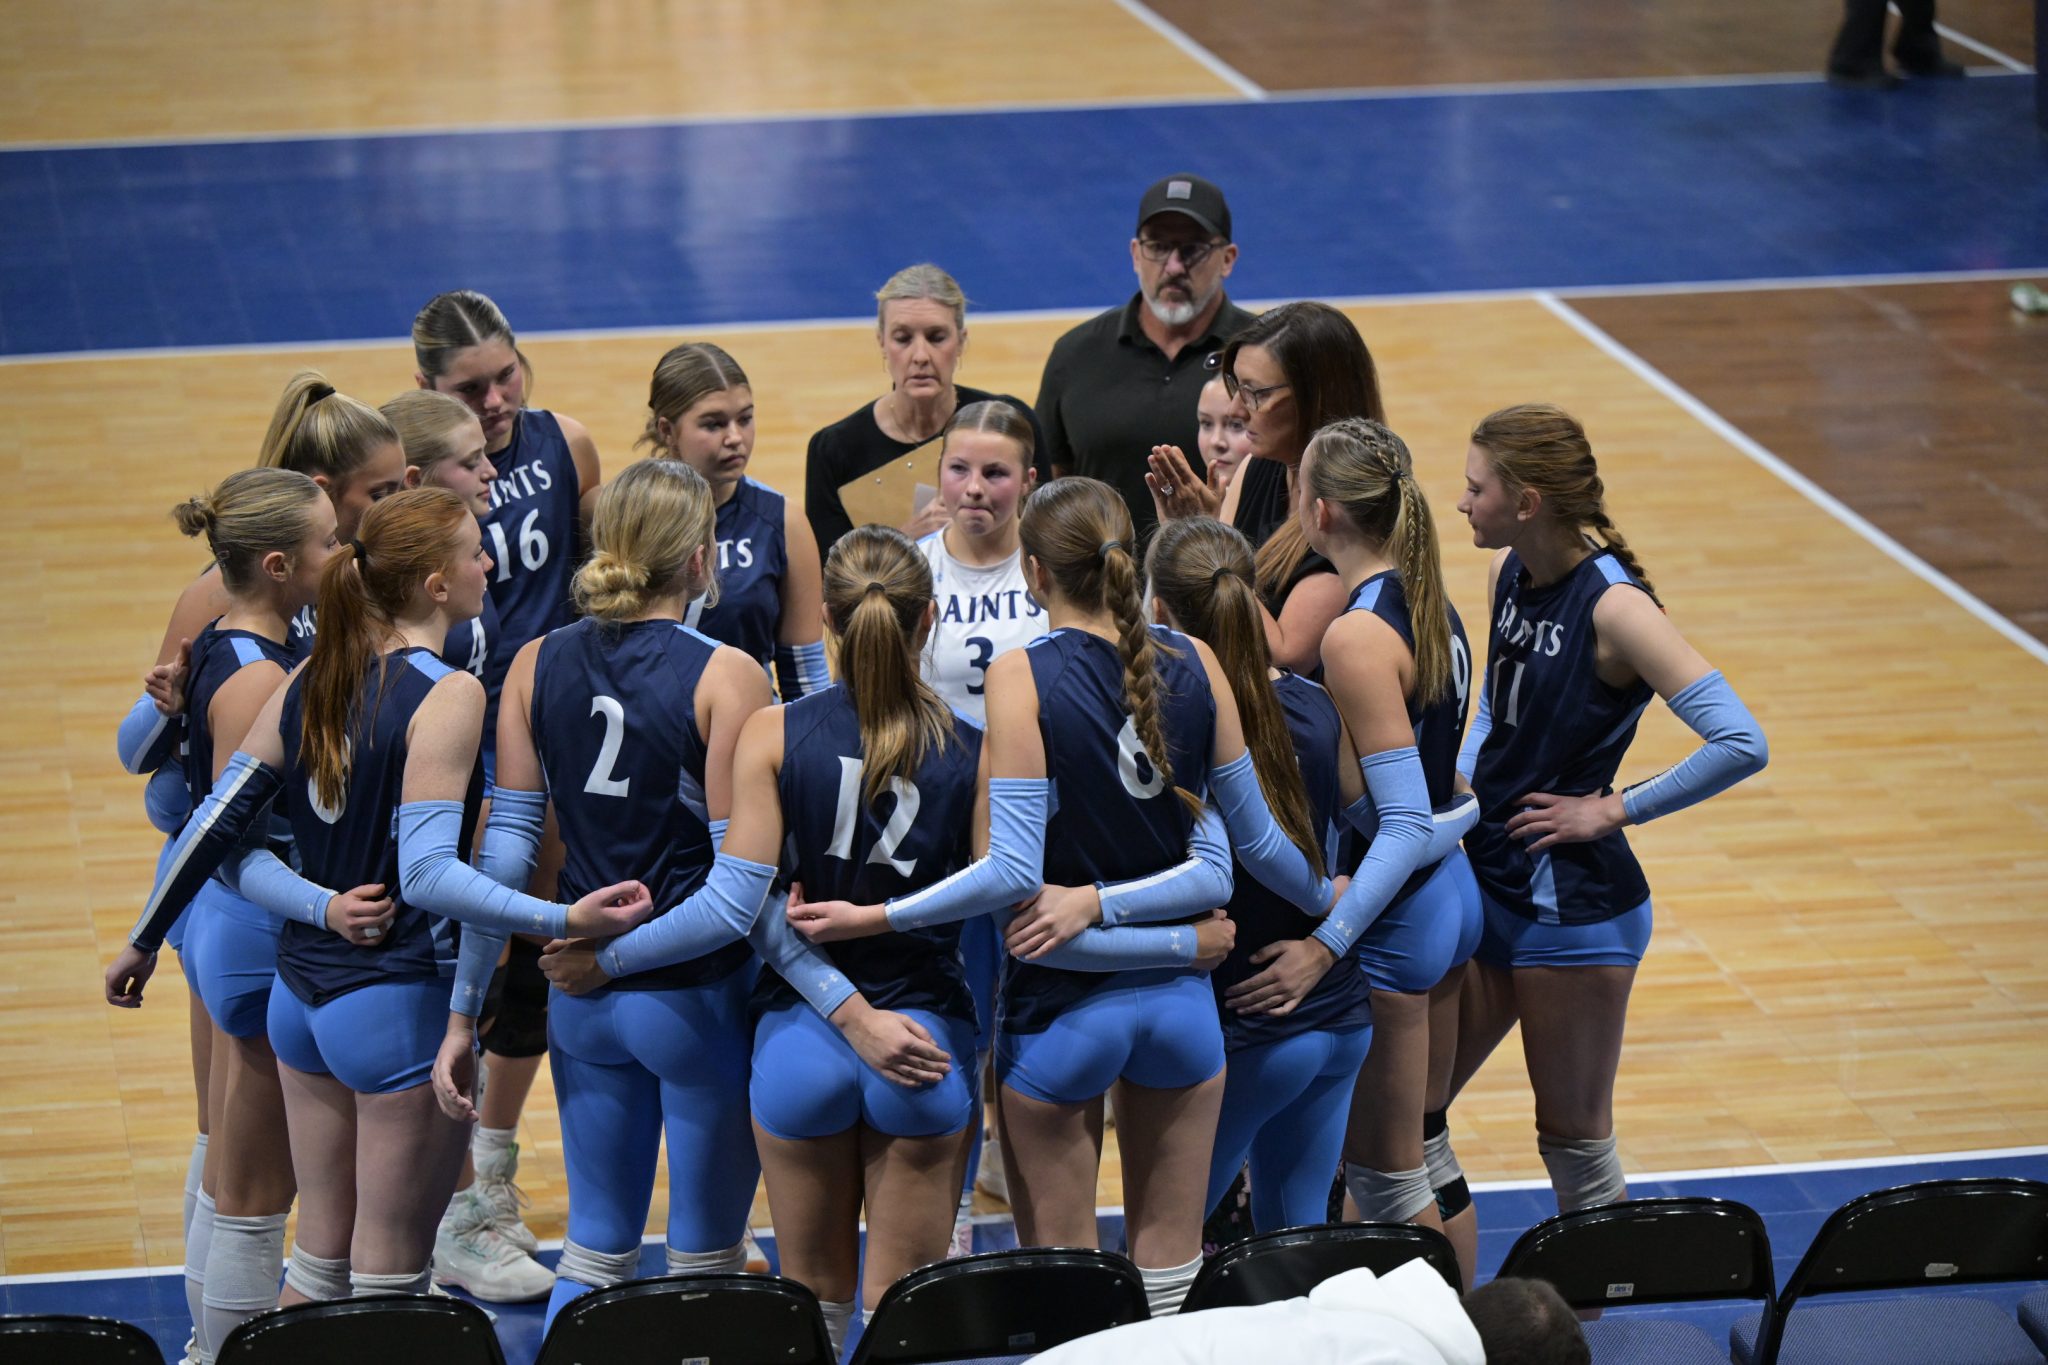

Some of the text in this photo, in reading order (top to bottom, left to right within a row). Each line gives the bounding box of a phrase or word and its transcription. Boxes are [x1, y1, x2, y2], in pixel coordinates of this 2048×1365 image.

[488, 459, 552, 510] INTS
[487, 508, 549, 583] 16
[934, 590, 1041, 623] AINTS
[466, 616, 488, 677] 4
[965, 636, 994, 695] 3
[583, 695, 630, 797] 2
[1117, 712, 1166, 799] 6
[824, 755, 920, 878] 12
